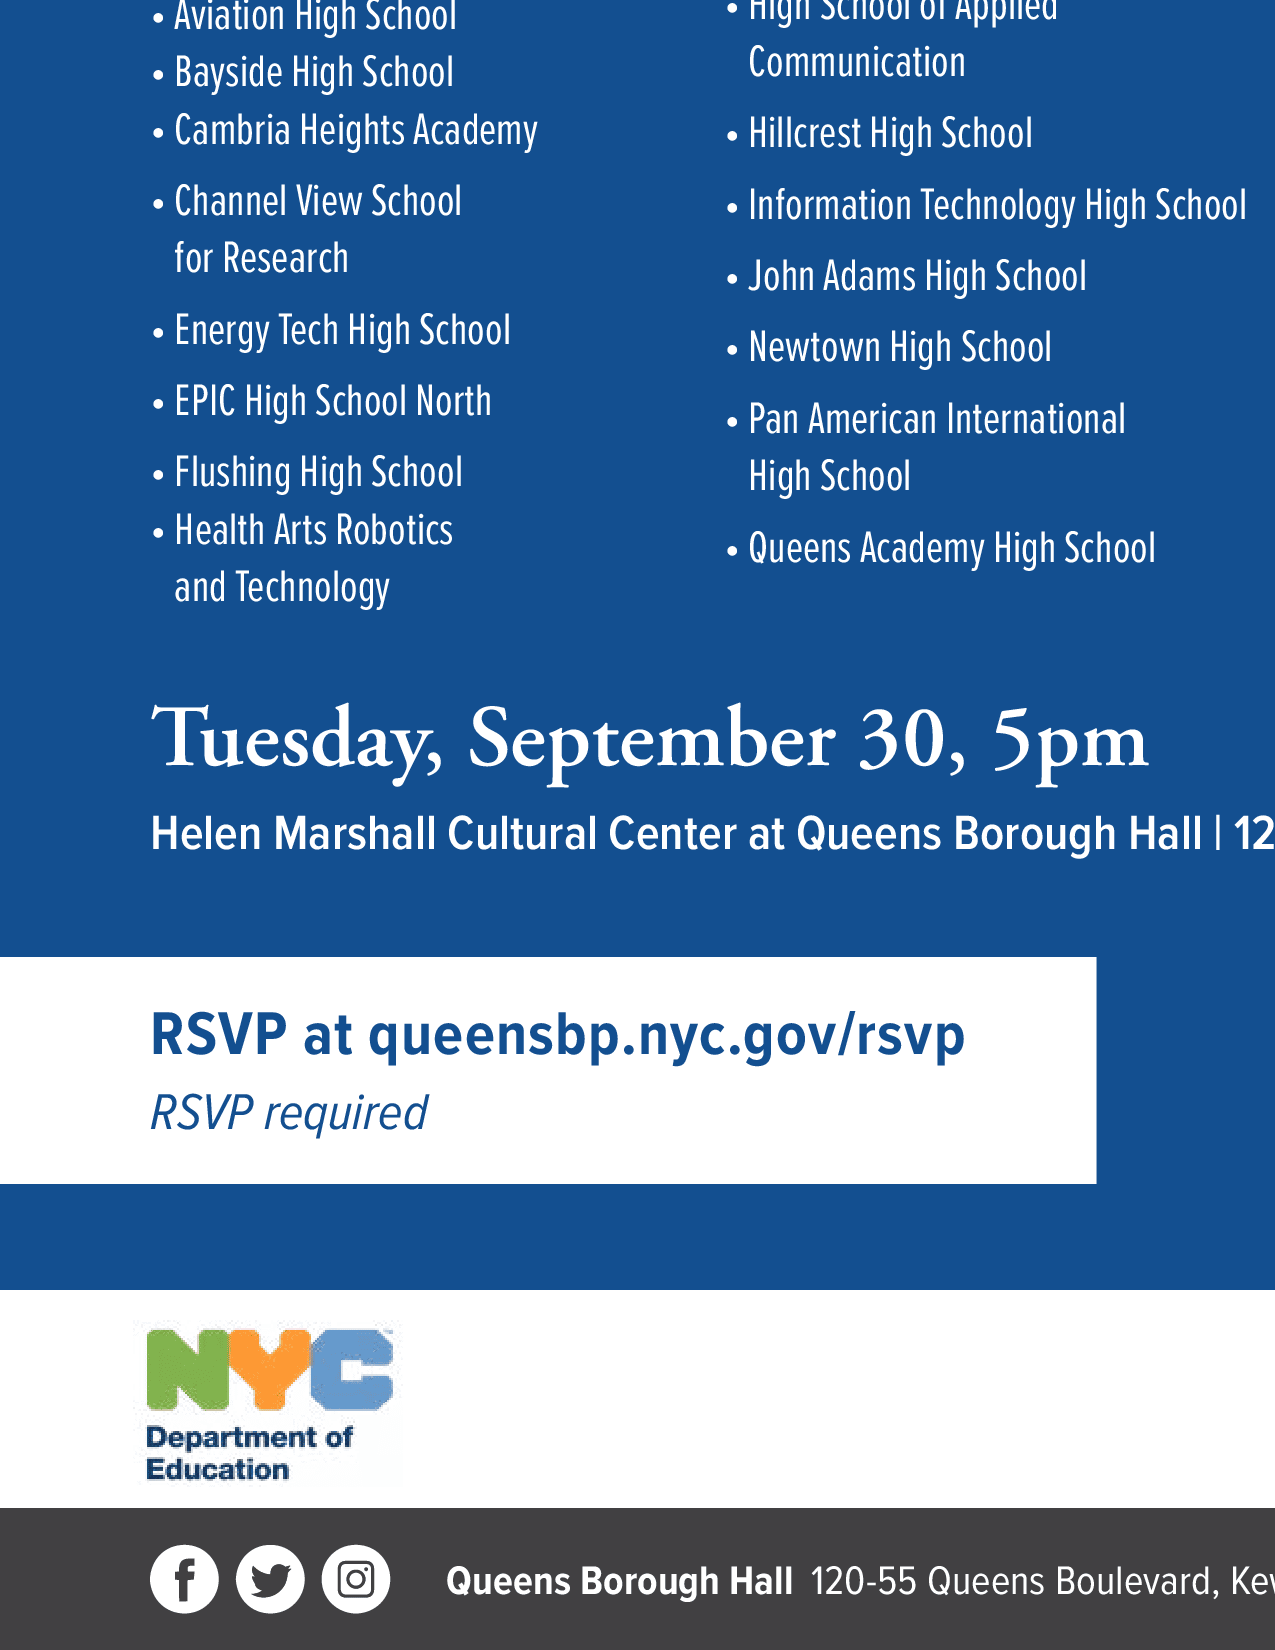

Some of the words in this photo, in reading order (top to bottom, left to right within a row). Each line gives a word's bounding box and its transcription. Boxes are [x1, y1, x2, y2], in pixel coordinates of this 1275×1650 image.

[750, 45, 964, 77] Communication
[176, 113, 289, 145] Cambria
[302, 113, 404, 153] Heights
[413, 113, 538, 153] Academy
[176, 184, 285, 216] Channel
[296, 184, 362, 216] View
[372, 184, 460, 216] School
[175, 241, 213, 273] for
[225, 241, 347, 273] Research
[177, 384, 234, 416] EPIC
[247, 384, 305, 424] High
[316, 384, 405, 416] School
[418, 384, 490, 416] North
[751, 402, 797, 434] Pan
[808, 402, 935, 434] American
[949, 402, 1124, 434] International
[751, 459, 809, 499] High
[821, 459, 909, 491] School
[177, 513, 263, 545] Health
[274, 513, 326, 545] Arts
[338, 513, 452, 545] Robotics
[175, 570, 224, 602] and
[236, 570, 390, 610] Technology
[151, 702, 441, 787] Tuesday,
[470, 702, 836, 788] September
[860, 709, 964, 776] 30,
[995, 708, 1149, 788] 5pm
[153, 816, 259, 850] Helen
[276, 816, 434, 850] Marshall
[449, 815, 595, 850] Cultural
[610, 815, 737, 850] Center
[750, 818, 785, 850] at
[798, 815, 941, 851] Queens
[956, 816, 1114, 859] Borough
[1131, 816, 1200, 850] Hall
[154, 1012, 286, 1055] RSVP
[305, 1015, 352, 1055] at
[370, 1011, 964, 1066] queensbp.nyc.gov/rsvp
[151, 1093, 254, 1130] RSVP
[265, 1094, 430, 1139] required
[147, 1329, 394, 1411] NYC
[146, 1425, 317, 1453] Department
[325, 1425, 354, 1448] of
[146, 1457, 290, 1481] Education
[447, 1566, 570, 1595] Queens
[582, 1566, 718, 1602] Borough
[731, 1566, 791, 1595] Hall
[812, 1566, 916, 1595] 120-55
[929, 1566, 1044, 1595] Queens
[1058, 1566, 1218, 1599] Boulevard,
